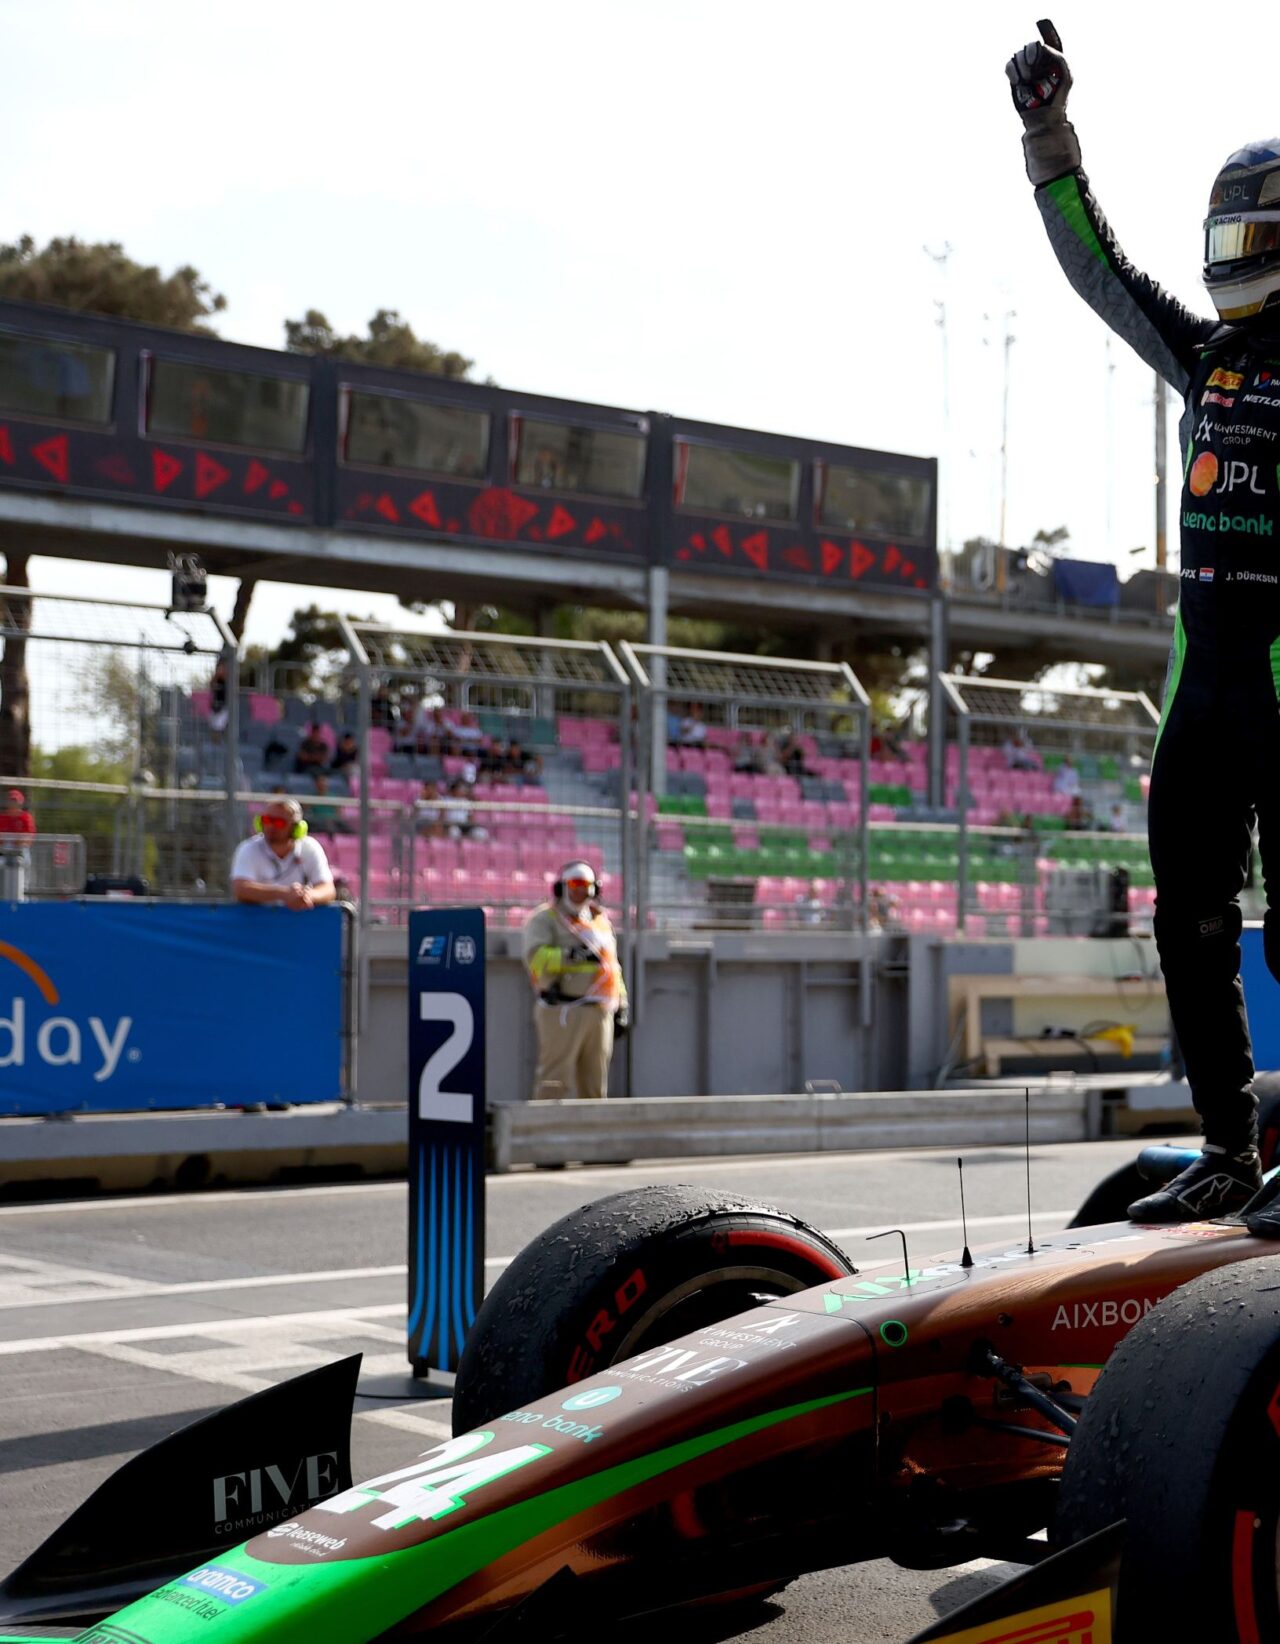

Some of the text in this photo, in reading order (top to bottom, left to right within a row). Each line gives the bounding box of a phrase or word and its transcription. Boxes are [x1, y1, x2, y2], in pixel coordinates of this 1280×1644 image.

[1223, 185, 1249, 202] UPL
[1183, 512, 1273, 536] ueno bank
[1236, 571, 1278, 584] DÜRKSEN
[418, 991, 474, 1123] 2
[500, 1411, 605, 1443] eno bank
[213, 1451, 340, 1523] FIVE
[312, 1430, 553, 1531] 24
[288, 1525, 348, 1551] leaseweb
[186, 1568, 255, 1600] aramco
